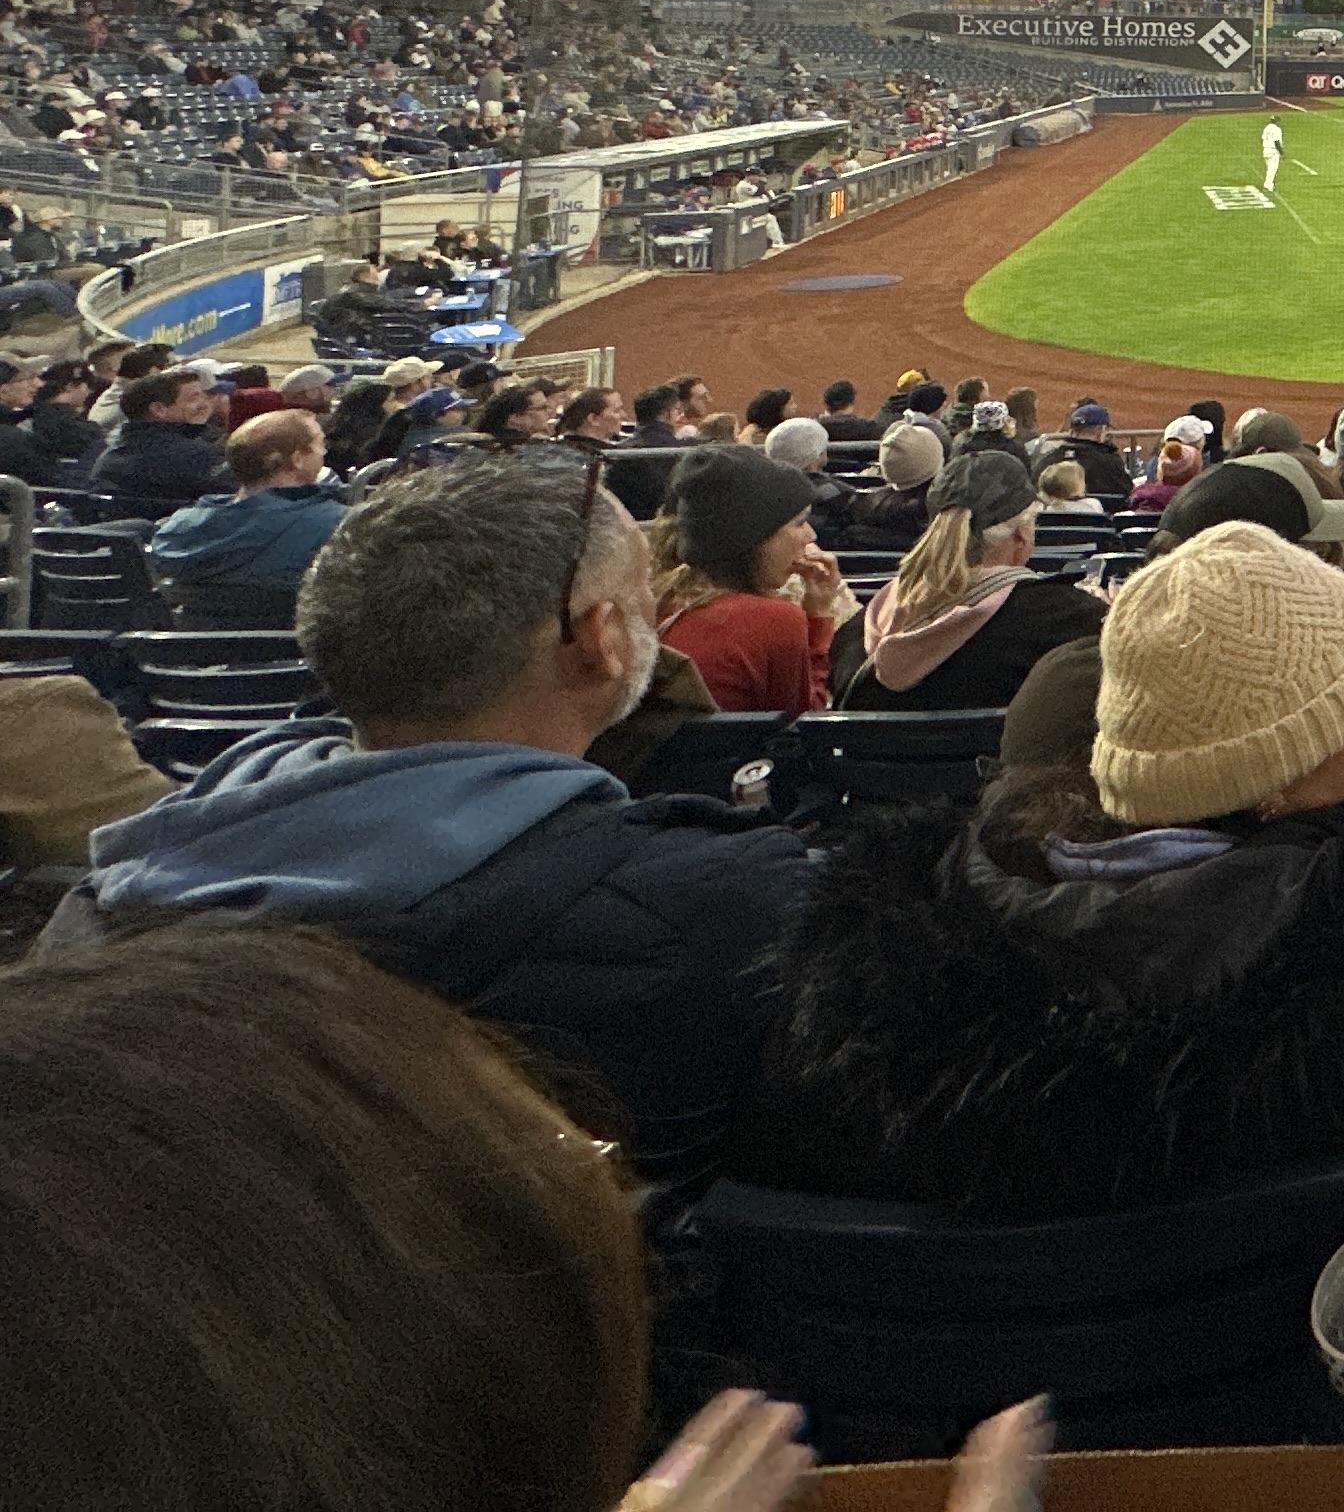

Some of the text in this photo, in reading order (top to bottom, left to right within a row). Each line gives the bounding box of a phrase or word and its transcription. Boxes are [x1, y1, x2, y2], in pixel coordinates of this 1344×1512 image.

[958, 13, 1196, 38] Executive Homes
[1031, 37, 1099, 46] BUILDING
[1308, 75, 1327, 88] QT
